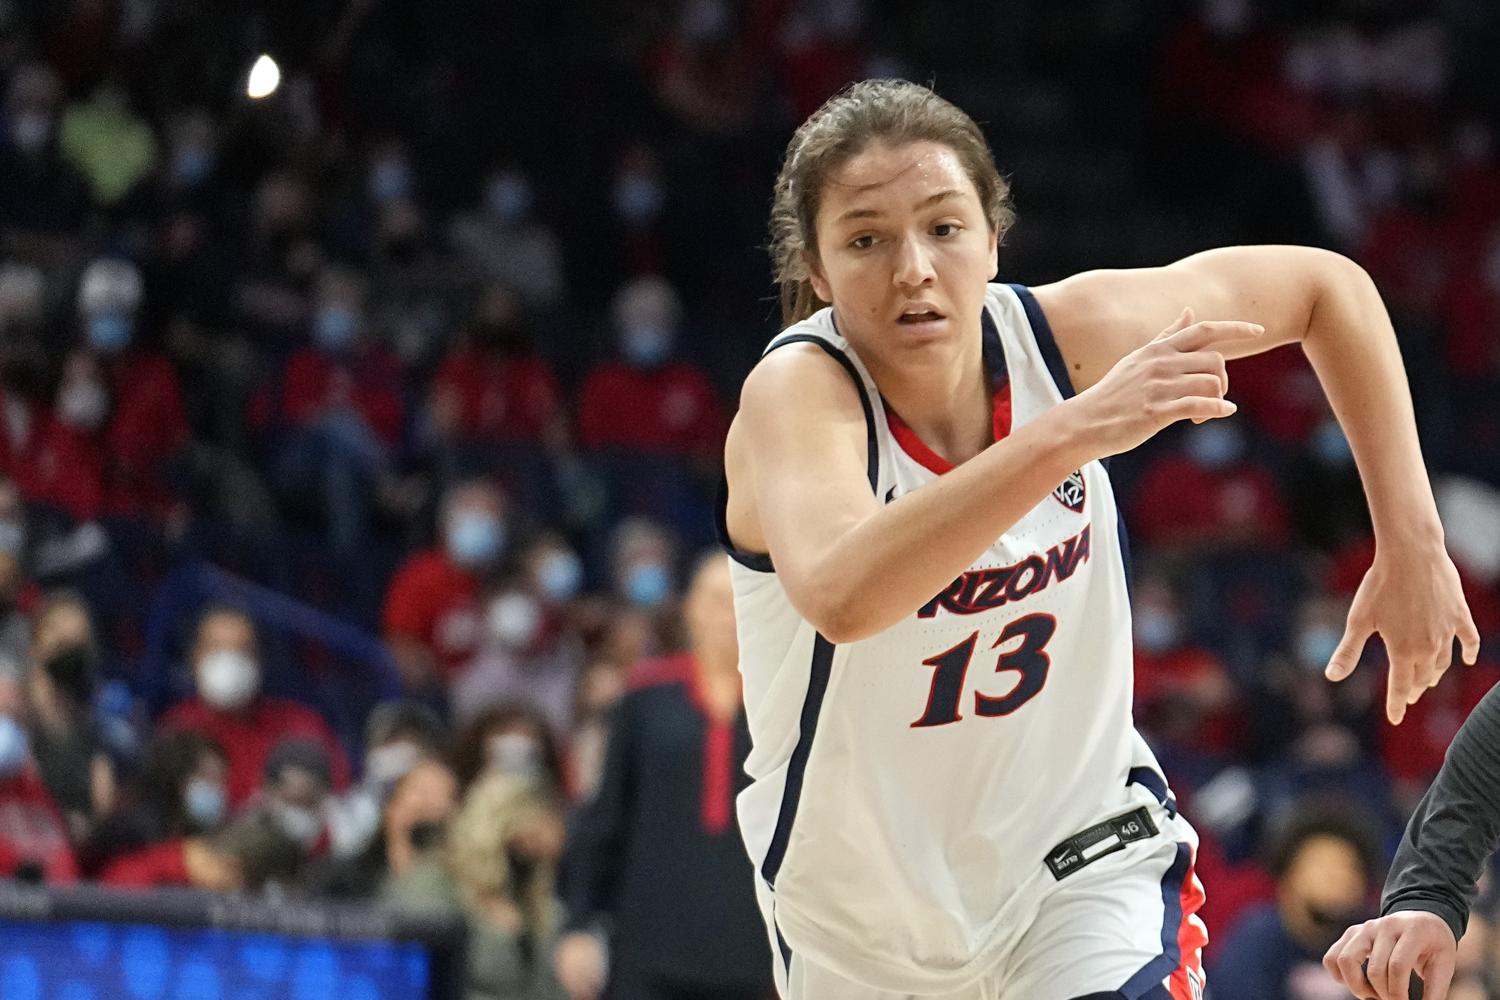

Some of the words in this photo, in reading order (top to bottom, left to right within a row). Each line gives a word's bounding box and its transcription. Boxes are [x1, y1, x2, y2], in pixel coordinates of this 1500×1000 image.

[917, 522, 1091, 618] RIZONA
[910, 613, 1057, 728] 13
[1121, 820, 1140, 836] 46
